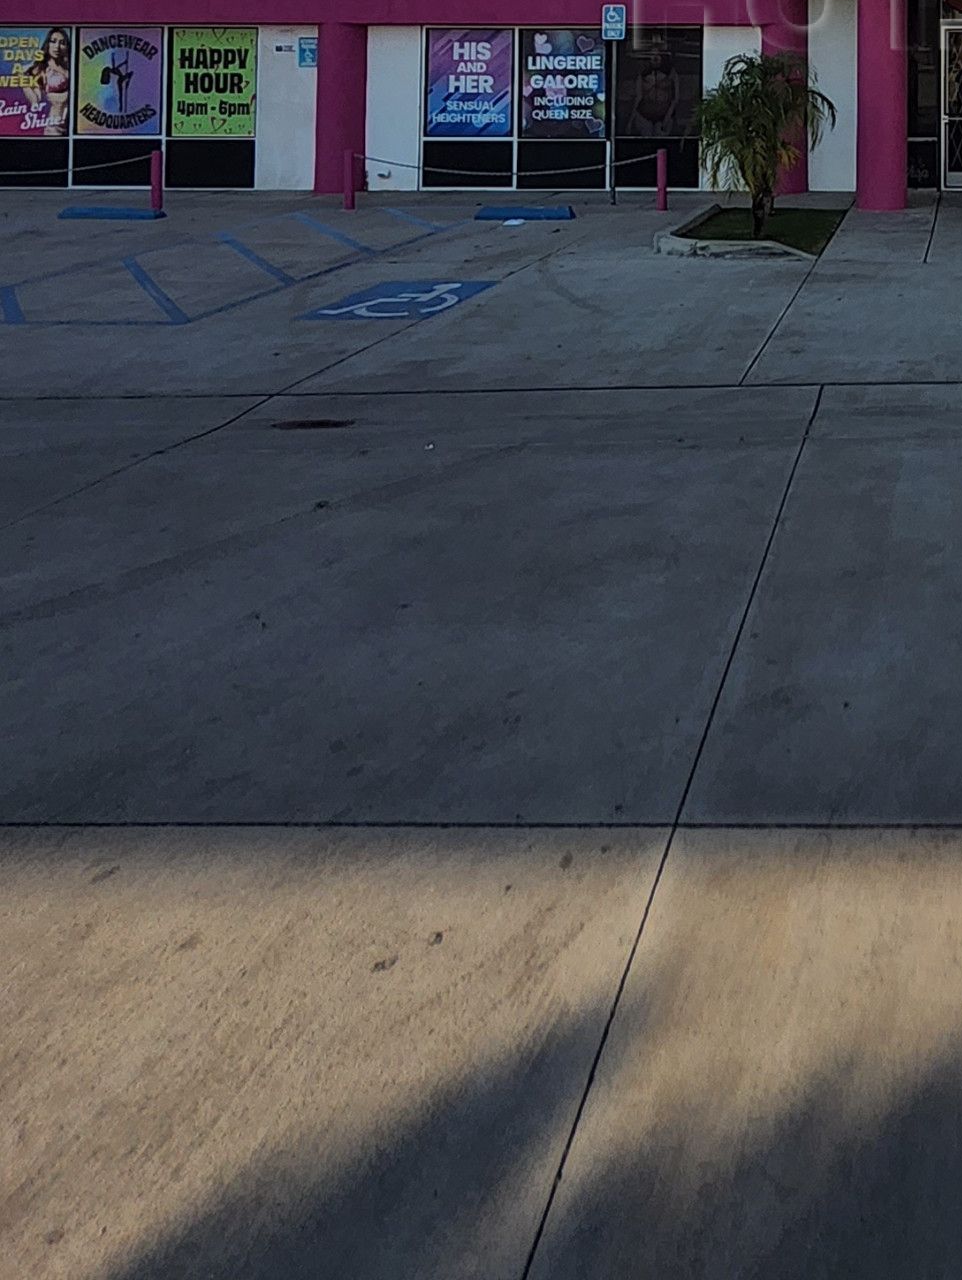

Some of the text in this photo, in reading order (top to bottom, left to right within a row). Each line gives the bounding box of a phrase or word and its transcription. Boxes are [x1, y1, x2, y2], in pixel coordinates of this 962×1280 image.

[0, 36, 39, 48] OPEN
[82, 34, 159, 61] DANCEWEAR
[4, 50, 45, 61] DAYS
[179, 48, 250, 69] HAPPY
[452, 42, 492, 61] HIS
[13, 63, 24, 75] A
[457, 62, 487, 73] AND
[527, 56, 601, 70] LINGERIE
[184, 73, 244, 94] HOUR
[449, 75, 494, 94] HER
[530, 75, 599, 89] GALORE
[31, 102, 47, 112] or
[446, 101, 496, 111] SENSUAL
[534, 96, 594, 106] INCLUDING
[176, 100, 208, 117] 4pm
[218, 100, 250, 117] 6pm
[532, 109, 593, 120] QUEEN SIZE
[20, 107, 68, 130] Shine!
[79, 103, 157, 129] HEADQUARTERS
[432, 113, 506, 123] HEIGHTENERS
